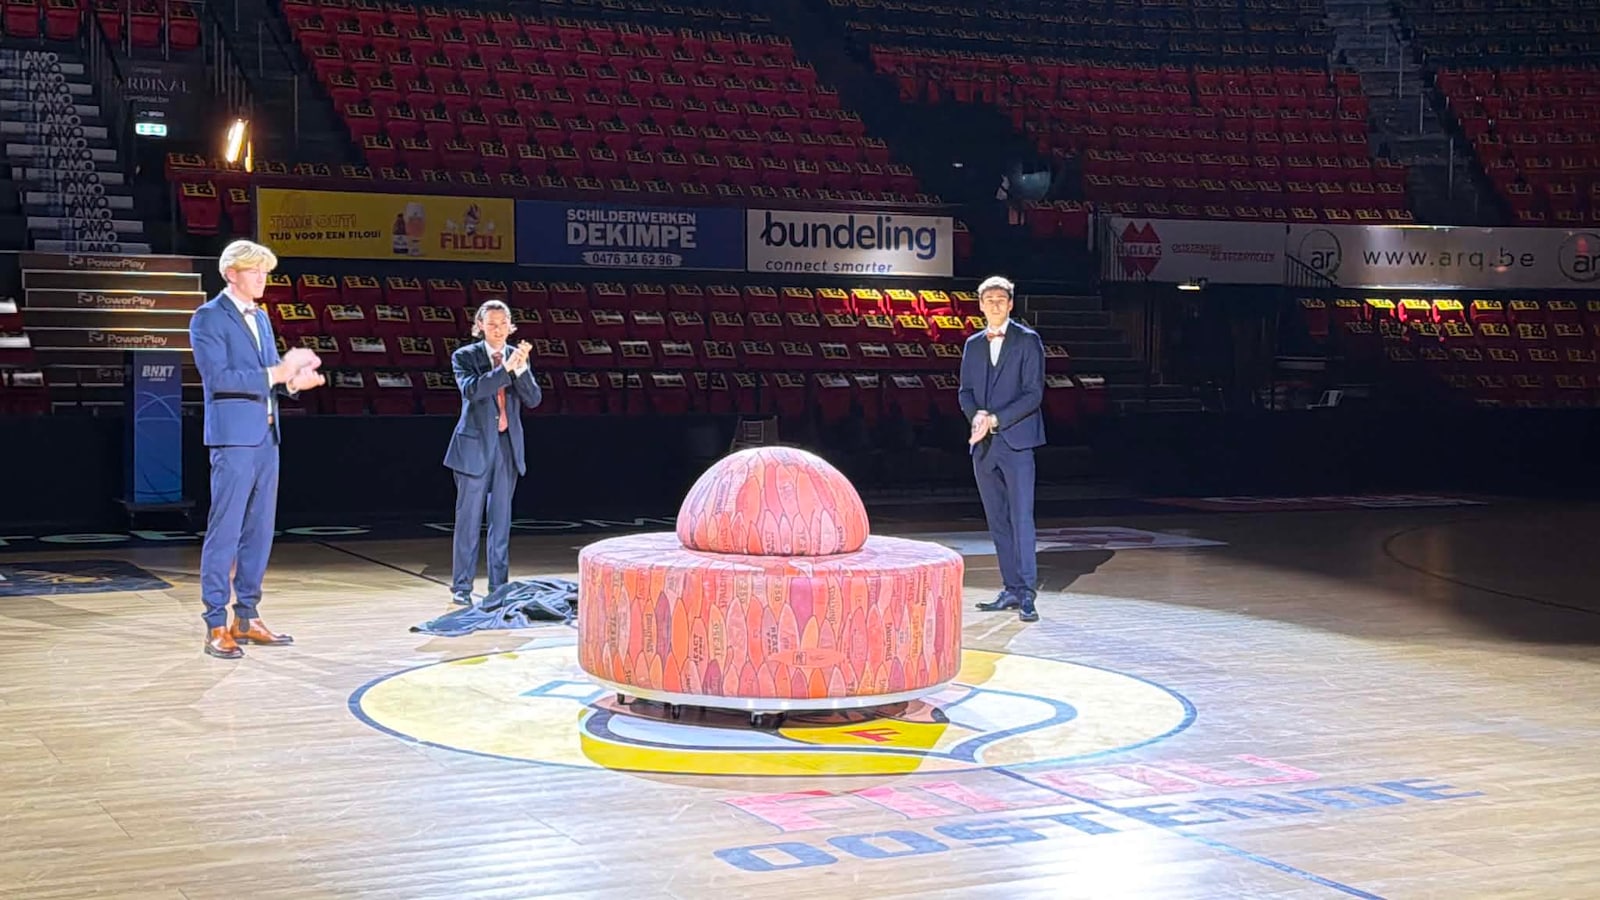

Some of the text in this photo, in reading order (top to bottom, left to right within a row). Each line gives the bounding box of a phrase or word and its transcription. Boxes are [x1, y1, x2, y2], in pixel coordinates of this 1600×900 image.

[566, 209, 696, 226] SCHILDERWERKEN
[270, 231, 291, 241] TIJD
[295, 231, 323, 240] VOOR
[326, 231, 346, 240] EEN
[440, 232, 504, 250] FILOU
[567, 223, 697, 249] DEKIMPE
[760, 211, 937, 260] bundeling
[87, 258, 146, 270] PowerPlay
[592, 252, 673, 266] 0476 34 62 96
[1362, 248, 1535, 271] www.arq.be
[765, 260, 893, 274] connect smarter
[96, 295, 156, 307] PowerPlay
[107, 333, 168, 345] PowerPlay
[142, 365, 174, 378] BNXT
[714, 777, 1482, 872] OOSTENDE
